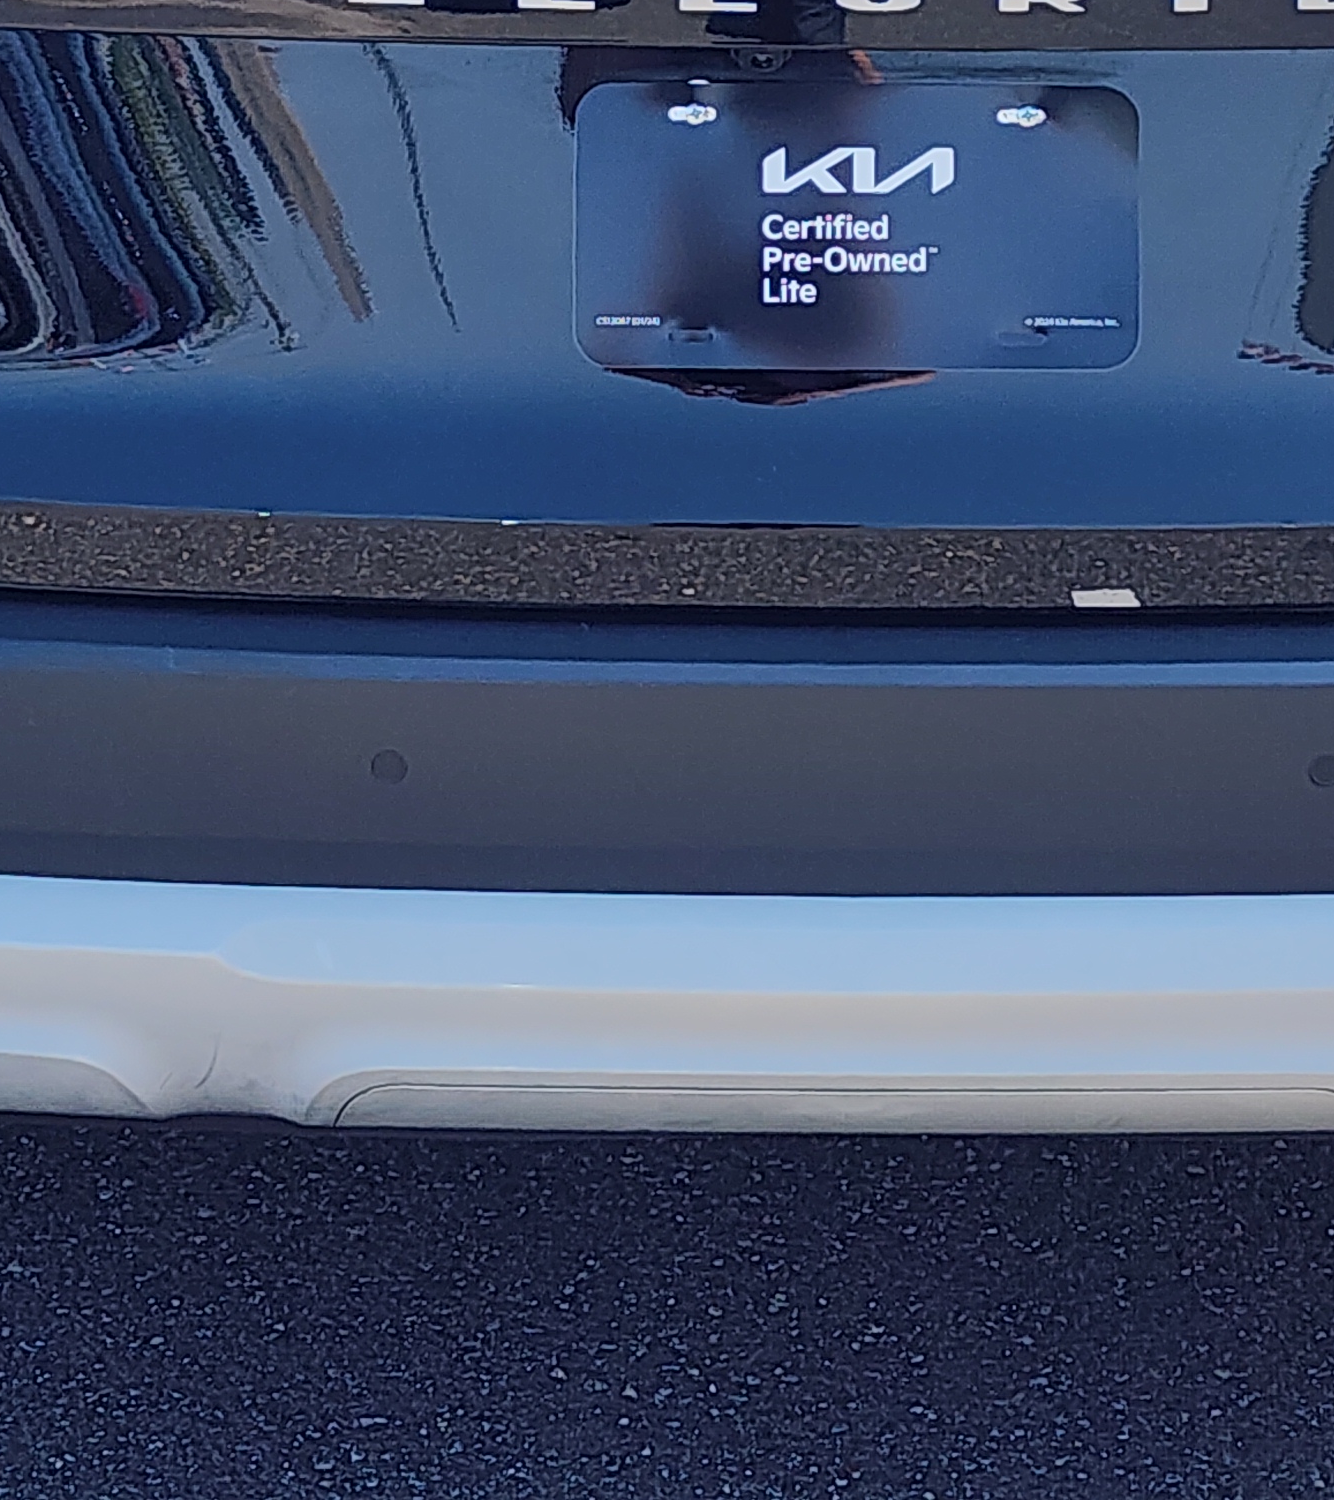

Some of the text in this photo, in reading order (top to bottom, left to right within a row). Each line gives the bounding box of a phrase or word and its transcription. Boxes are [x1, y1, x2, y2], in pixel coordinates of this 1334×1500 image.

[762, 146, 955, 195] KIA
[761, 213, 890, 241] Certified
[762, 277, 818, 304] Lite
